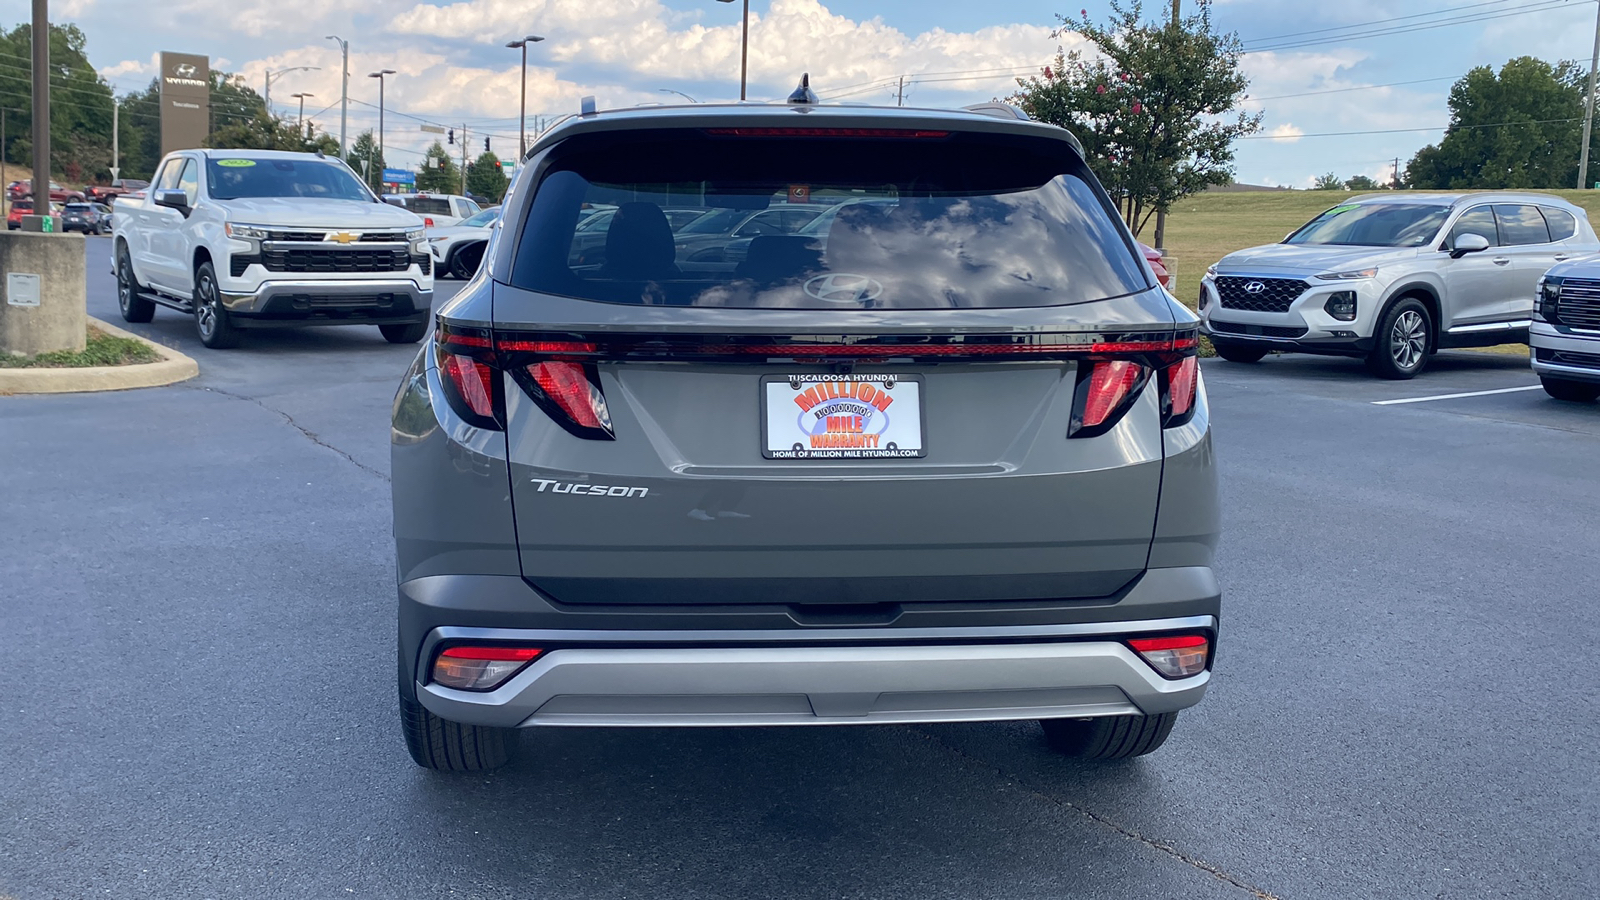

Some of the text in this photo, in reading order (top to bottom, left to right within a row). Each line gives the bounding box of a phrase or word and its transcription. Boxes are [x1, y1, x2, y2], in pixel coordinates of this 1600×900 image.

[788, 374, 898, 382] TUSCALOOSA HYUNDAI
[793, 381, 894, 413] MILLION
[826, 415, 863, 434] MILE
[810, 433, 881, 449] WARRANTY
[772, 449, 919, 458] HOME OF MILLION MILE HYUNDAI.COM
